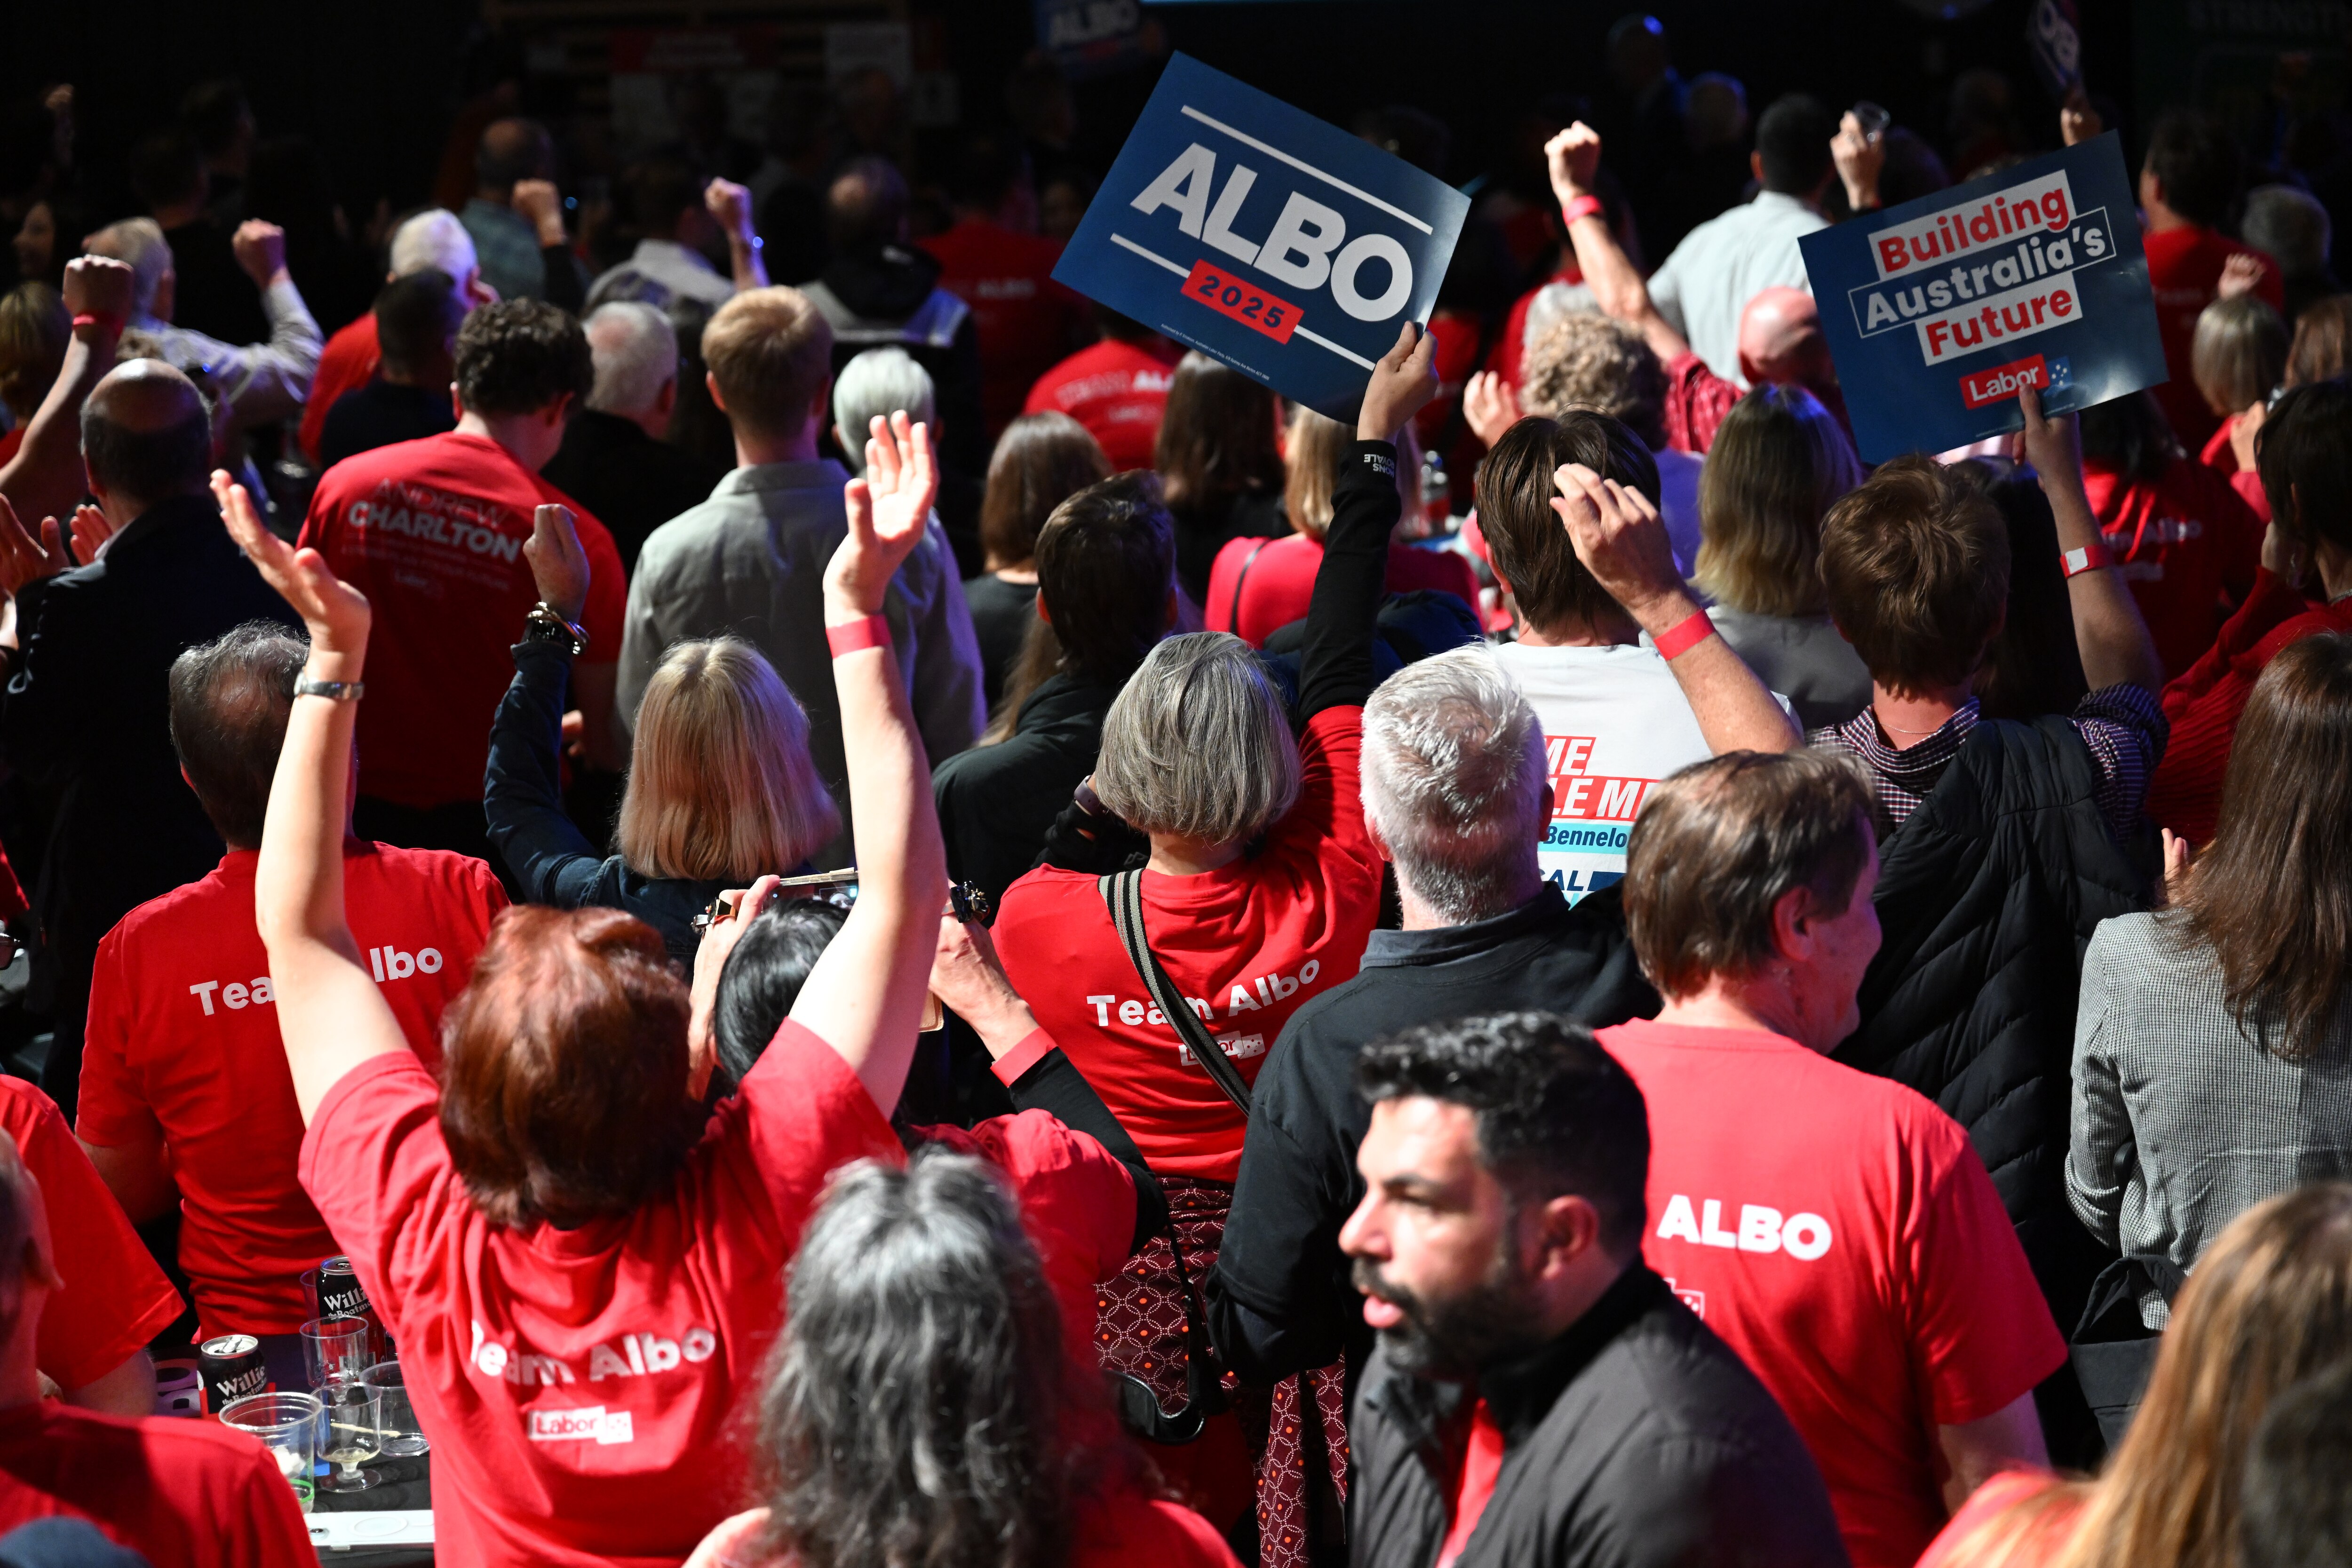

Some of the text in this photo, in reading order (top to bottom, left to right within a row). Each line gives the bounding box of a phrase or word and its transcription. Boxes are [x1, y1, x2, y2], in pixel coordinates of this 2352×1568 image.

[1130, 143, 1413, 322] ALBO
[1878, 188, 2069, 273] Building
[1198, 275, 1286, 328] 2025
[1867, 226, 2106, 329] Australia's
[1926, 289, 2073, 357] Future
[1970, 366, 2039, 402] Labor
[1364, 454, 1395, 470] ROYALE
[375, 477, 510, 529] ANDREW
[348, 500, 522, 565] CHARLTON
[1543, 826, 1628, 848] Bennelo
[1539, 868, 1584, 891] AL
[190, 945, 443, 1016] Tea lbo
[1087, 959, 1320, 1027] Team Albo
[1186, 1039, 1235, 1062] Lor
[1656, 1194, 1832, 1261] ALBO
[324, 1287, 367, 1311] Willi
[589, 1327, 716, 1382] Albo
[216, 1366, 265, 1397] Willie
[535, 1415, 598, 1435] Labor
